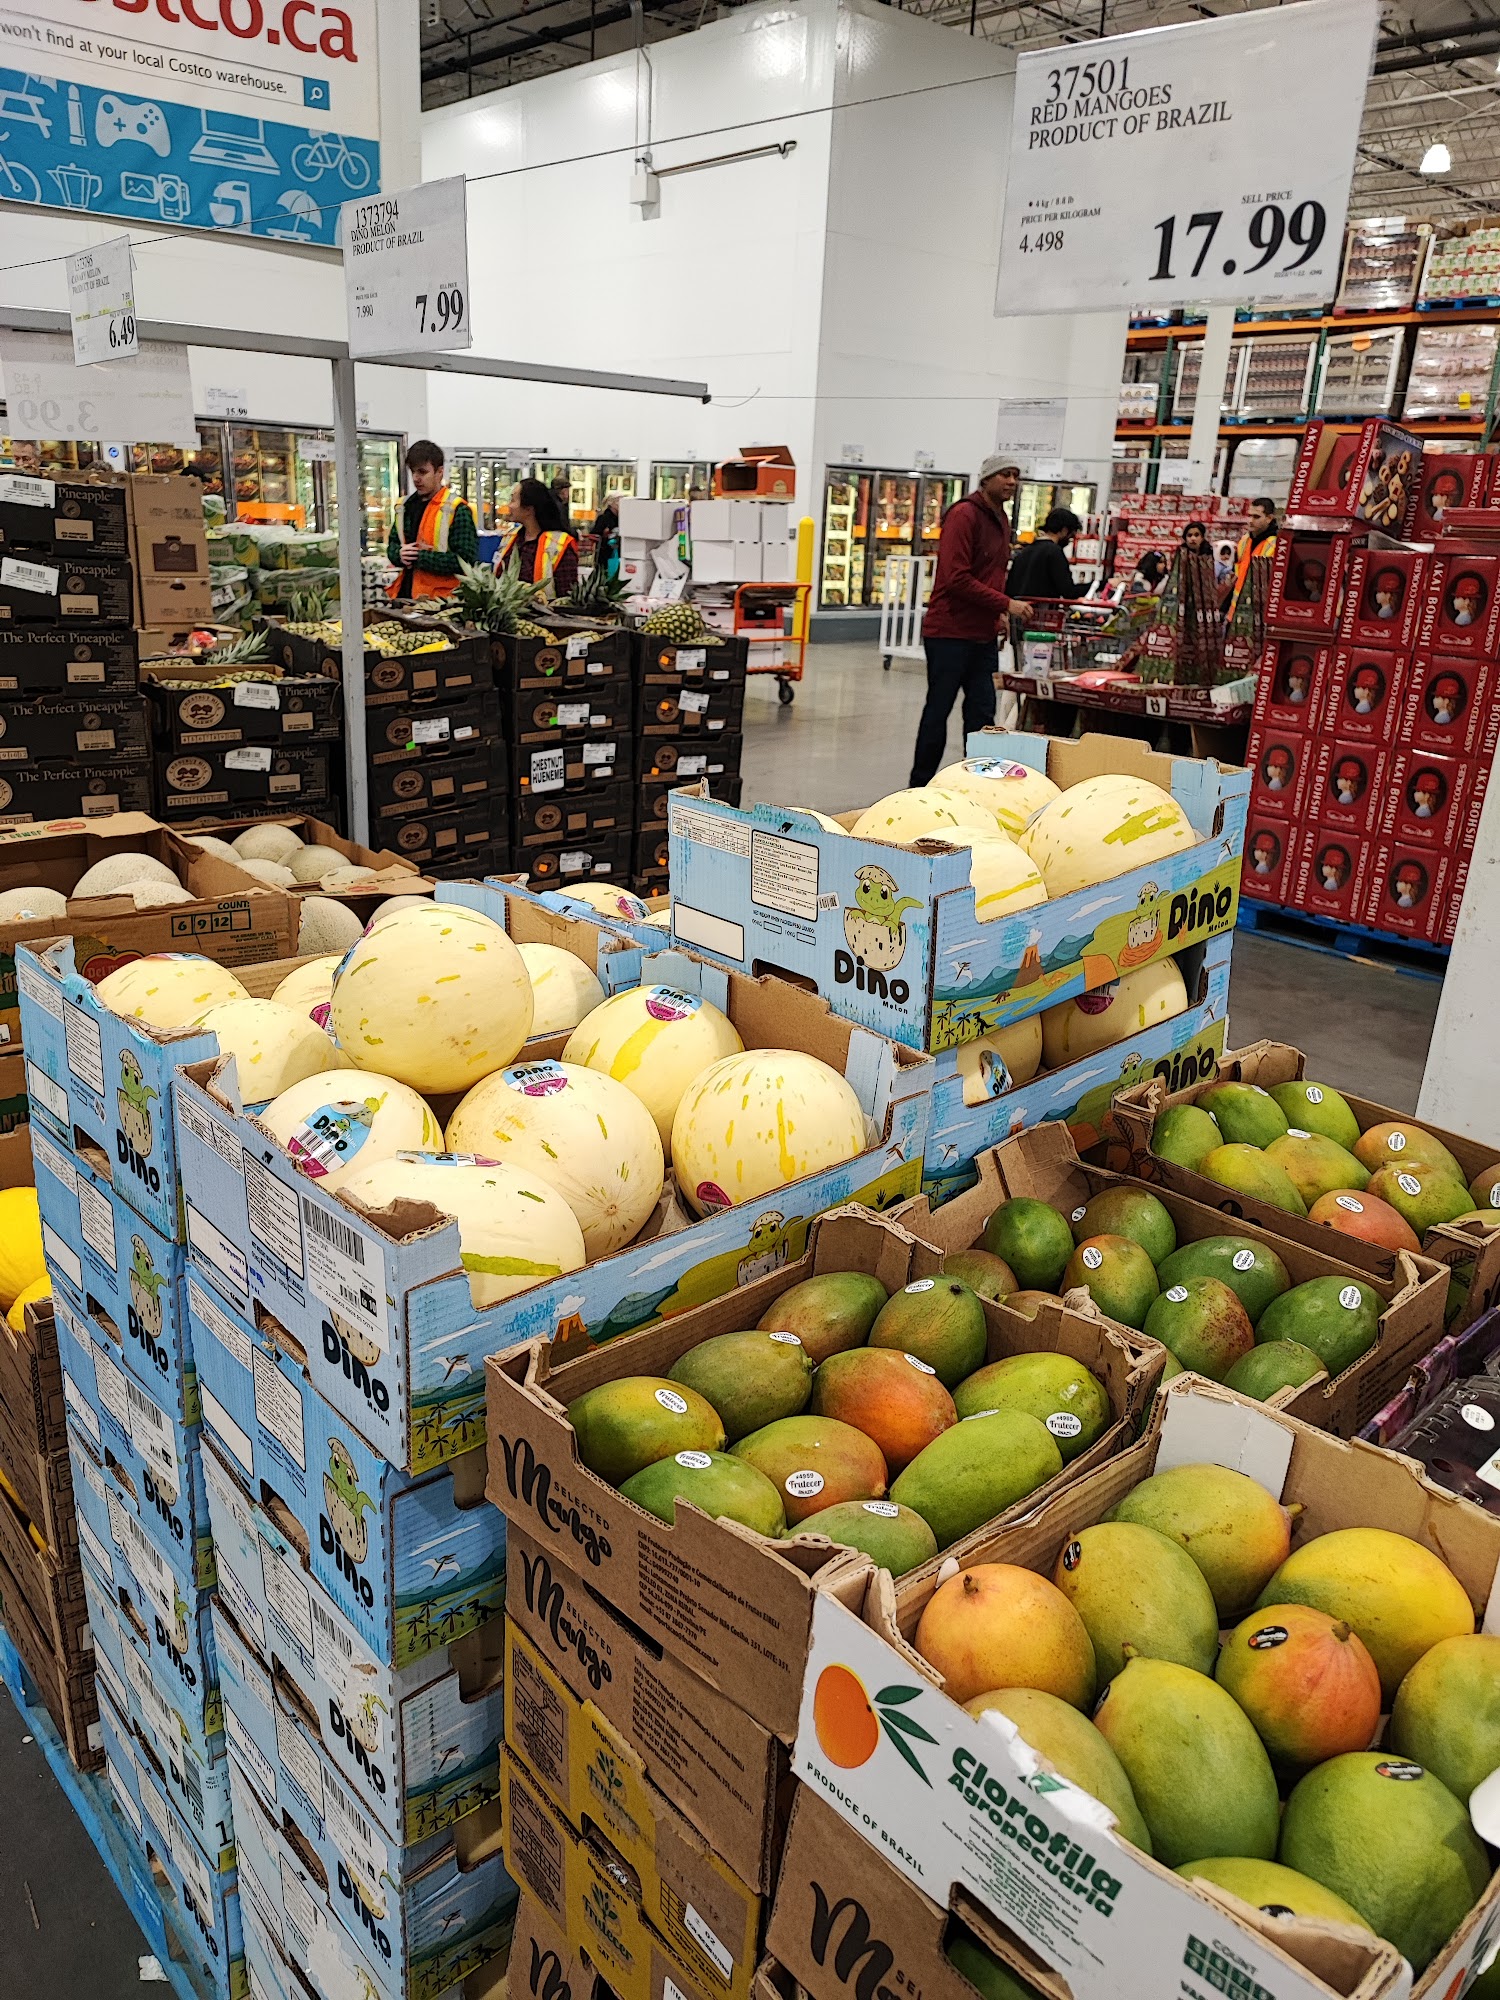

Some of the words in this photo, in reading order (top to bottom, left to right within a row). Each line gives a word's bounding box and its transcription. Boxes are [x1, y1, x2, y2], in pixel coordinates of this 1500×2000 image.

[78, 0, 358, 62] co.ca
[0, 23, 41, 41] won't
[47, 29, 74, 49] find
[79, 40, 92, 53] at
[97, 44, 128, 61] your
[133, 50, 164, 69] local
[169, 58, 212, 79] Costco
[216, 70, 287, 94] warehouse.
[1046, 57, 1130, 104] 37501
[1031, 102, 1068, 126] RED
[1073, 84, 1172, 119] MANGOES
[1028, 118, 1118, 150] PRODUCT
[1123, 113, 1151, 135] OF
[1156, 101, 1233, 132] BRAZIL
[1241, 194, 1264, 205] SELL
[1265, 190, 1293, 202] PRICE
[355, 199, 399, 229] 1373794
[1021, 214, 1043, 227] PRICE
[1044, 211, 1058, 223] PER
[1060, 207, 1101, 221] KILOGRAM
[351, 227, 369, 242] DINO
[370, 221, 396, 239] MELON
[352, 239, 384, 257] PRODUCT
[385, 236, 397, 249] OF
[397, 231, 425, 247] BRAZIL
[1019, 230, 1064, 253] 4.498
[1148, 200, 1327, 281] 17.99
[356, 304, 374, 318] 7.990
[415, 289, 464, 333] 7.99
[109, 315, 135, 348] 6.49
[57, 487, 112, 504] Pineapple
[64, 562, 117, 578] Pineapple
[1430, 560, 1445, 592] AKAI
[1419, 596, 1438, 647] BOHSHI
[0, 631, 24, 644] The
[27, 632, 66, 644] Perfect
[69, 632, 121, 646] Pineapple
[1411, 659, 1426, 690] AKAI
[10, 704, 34, 716] The
[38, 703, 75, 715] Perfect
[79, 699, 130, 714] Pineapple
[285, 686, 328, 698] Pineapple
[1400, 694, 1419, 742] BOHSHI
[272, 747, 315, 761] Pineapple
[532, 756, 564, 772] CHESTNUT
[16, 771, 40, 783] The
[43, 769, 81, 781] Perfect
[84, 765, 137, 778] Pineapple
[532, 769, 564, 785] HUENEME
[1473, 766, 1488, 798] AKAI
[1454, 860, 1469, 890] AKAI
[217, 900, 250, 910] COUNT:
[1167, 887, 1232, 940] Dino
[177, 920, 187, 931] 6
[197, 919, 207, 929] 9
[213, 916, 229, 927] 12
[1207, 918, 1229, 934] Melon
[833, 948, 910, 1005] Dino
[660, 987, 693, 1005] Dino
[882, 1000, 908, 1015] Melon
[512, 1064, 553, 1081] Dino
[1152, 1047, 1216, 1092] Dino
[312, 1114, 348, 1152] Dino
[116, 1128, 161, 1193] Dino
[127, 1303, 169, 1373] Dino
[321, 1319, 390, 1412] Dino
[658, 1390, 685, 1413] Frutecer
[1049, 1421, 1080, 1432] Frutecer
[679, 1452, 709, 1467] Frutecer
[788, 1478, 822, 1489] Frutecer
[142, 1468, 184, 1542] Dino
[498, 1433, 612, 1567] Mango
[554, 1480, 610, 1532] SELECTED
[319, 1512, 374, 1609] Dino
[519, 1549, 613, 1691] Mango
[565, 1600, 612, 1656] SELECTED
[154, 1614, 197, 1687] Dino
[328, 1697, 386, 1794] Dino
[806, 1761, 861, 1817] PRODUCE
[861, 1813, 878, 1830] OF
[880, 1829, 925, 1877] BRAZIL
[951, 1746, 1123, 1902] Clorofila
[947, 1771, 1115, 1918] Agropecuária
[337, 1859, 392, 1959] Dino
